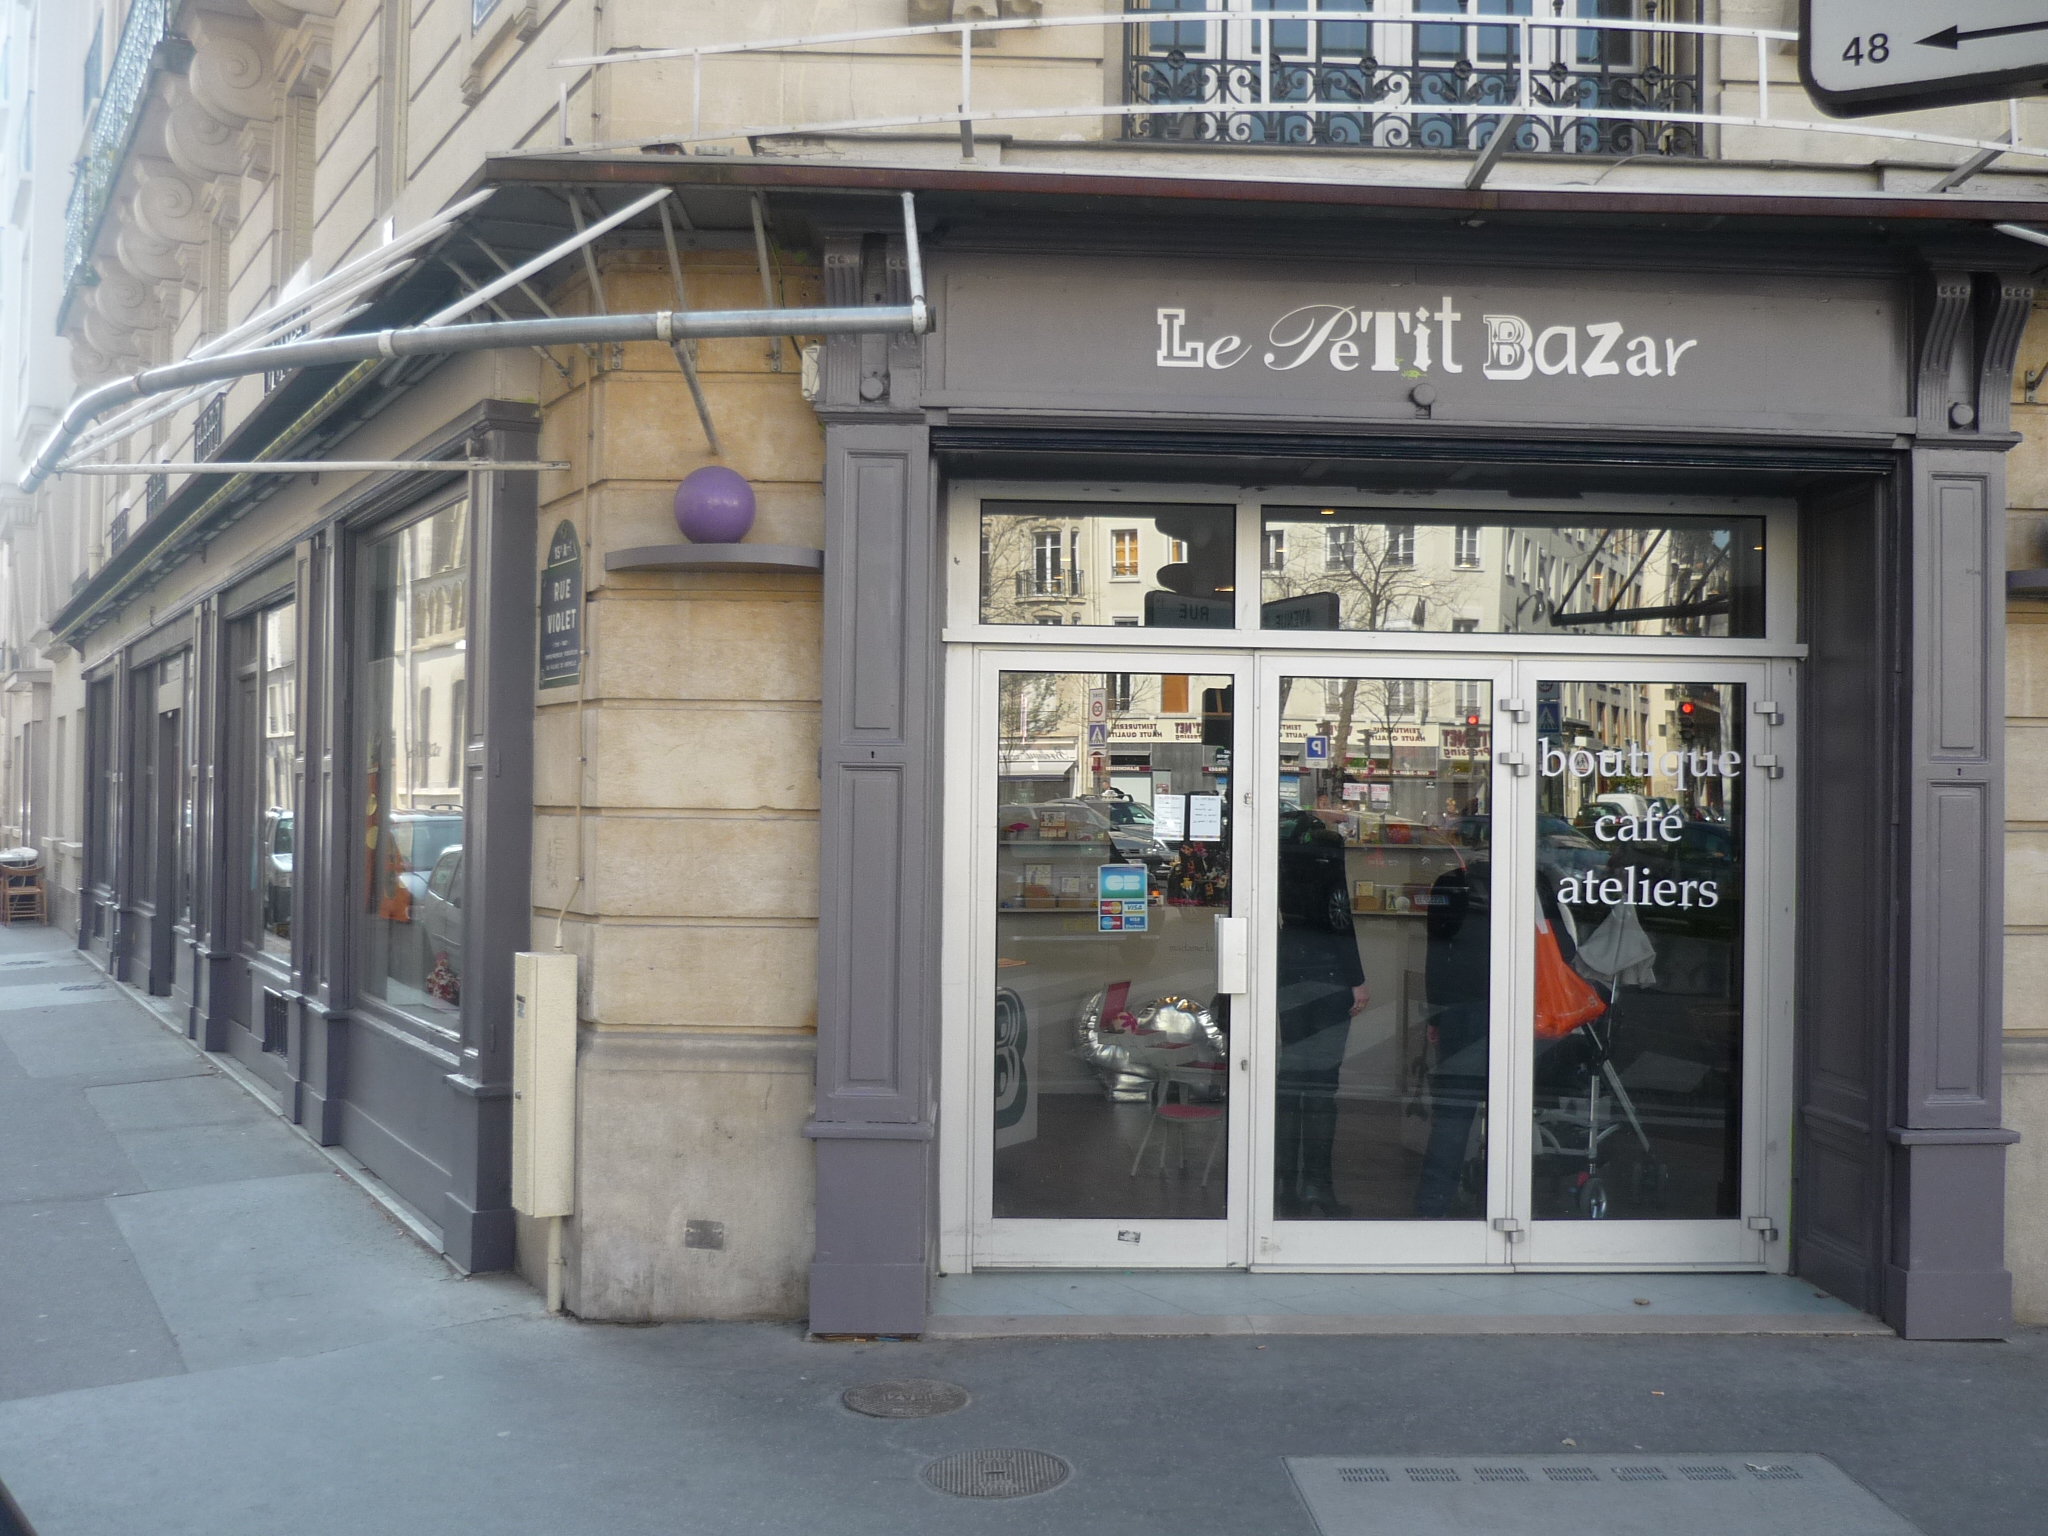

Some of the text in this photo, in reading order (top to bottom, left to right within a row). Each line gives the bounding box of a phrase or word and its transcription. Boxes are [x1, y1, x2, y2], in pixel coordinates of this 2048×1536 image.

[1842, 33, 1890, 66] 48
[1156, 308, 1252, 371] Le
[554, 579, 571, 602] RUE
[547, 608, 577, 634] VIOLET
[1538, 737, 1741, 791] boutique
[1594, 801, 1683, 842] café
[1557, 865, 1719, 910] ateliers
